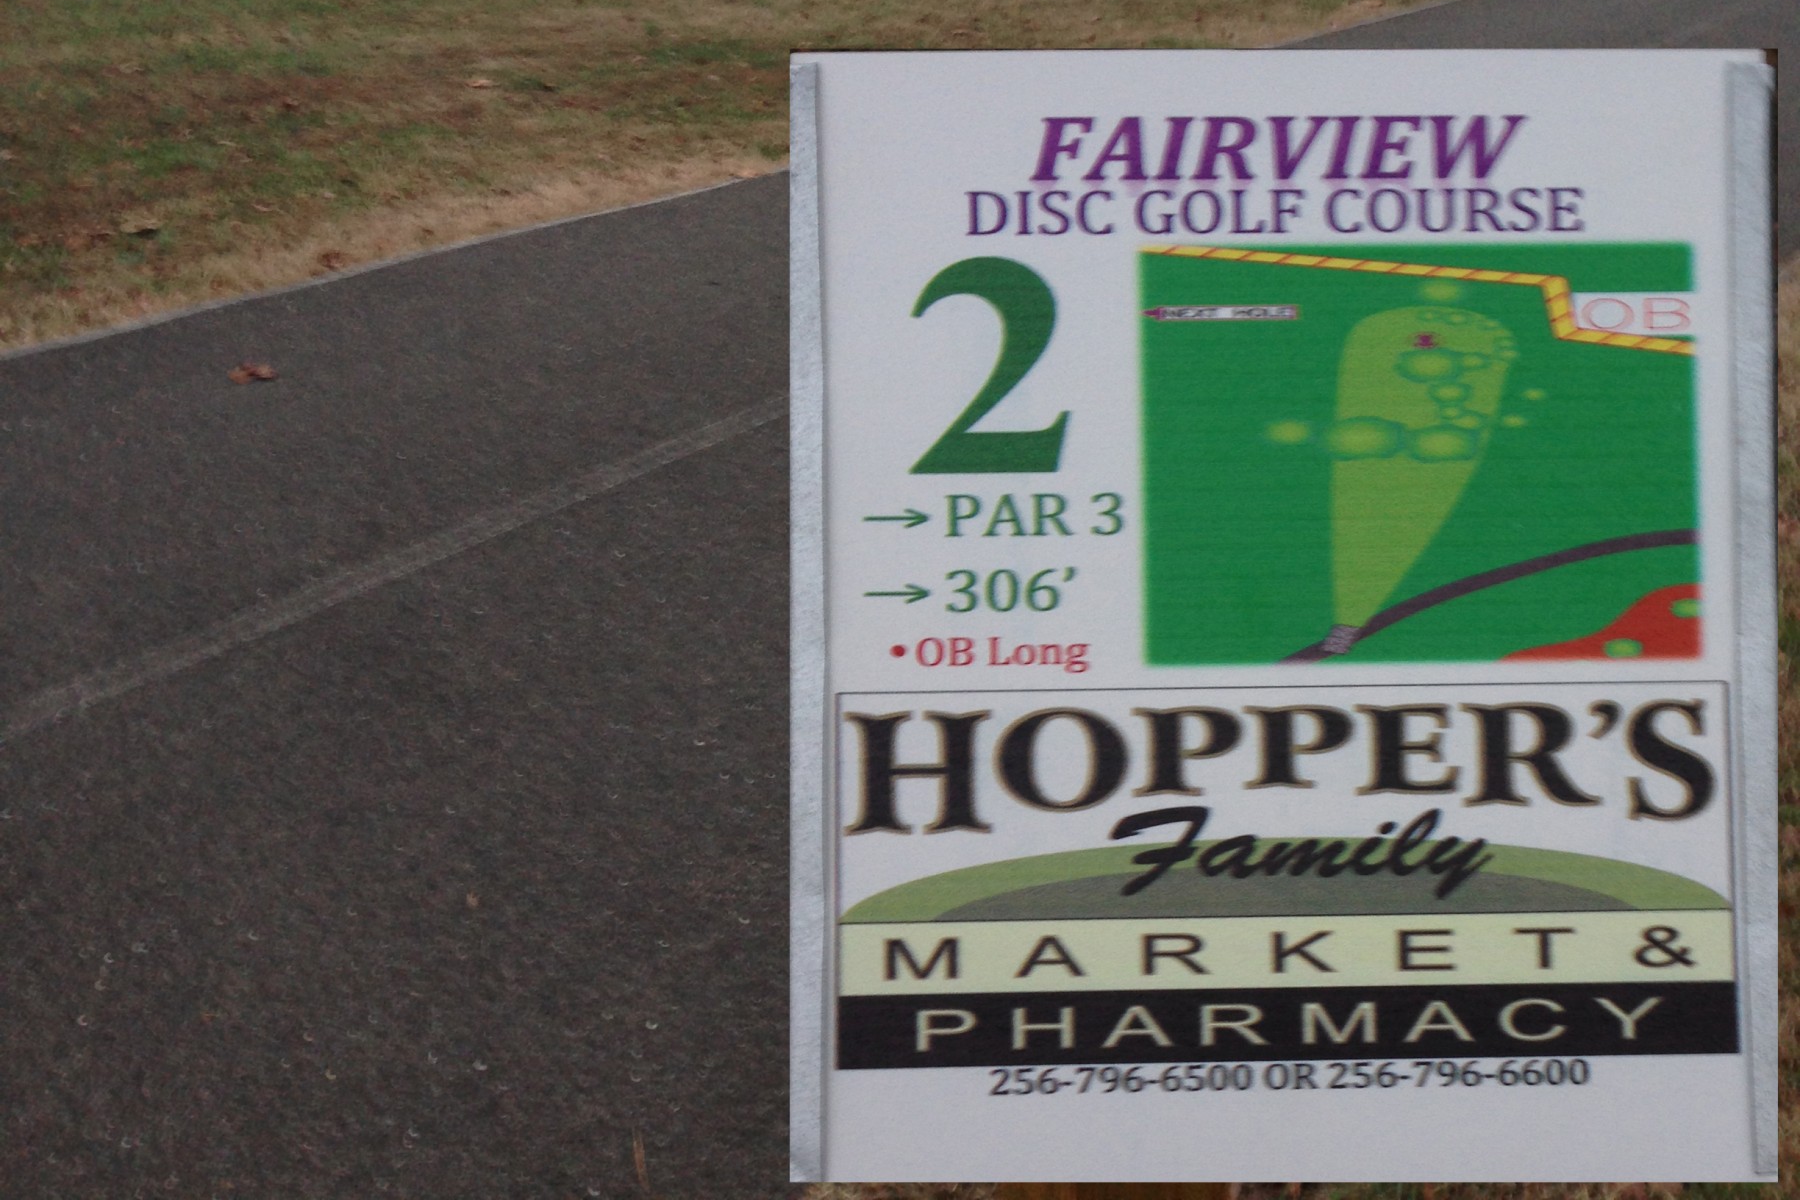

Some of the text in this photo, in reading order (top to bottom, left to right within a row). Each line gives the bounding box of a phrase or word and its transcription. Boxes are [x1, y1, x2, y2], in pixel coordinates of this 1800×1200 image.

[1029, 115, 1527, 182] FAIRVIEW
[966, 187, 1585, 237] DISC GOLF COURSE
[1161, 307, 1294, 319] NEXT HOLE
[1581, 298, 1691, 330] OB
[909, 257, 1071, 474] 2
[943, 493, 1124, 538] PAR 3
[945, 567, 1077, 613] 306'
[915, 636, 1091, 674] OB Long
[844, 697, 1717, 835] HOPPER'S
[1108, 805, 1492, 900] Family
[883, 924, 1696, 980] MARKET &
[916, 995, 1664, 1053] PHARMACY
[988, 1058, 1591, 1097] 256-796-6500 OR 256-796-6600
